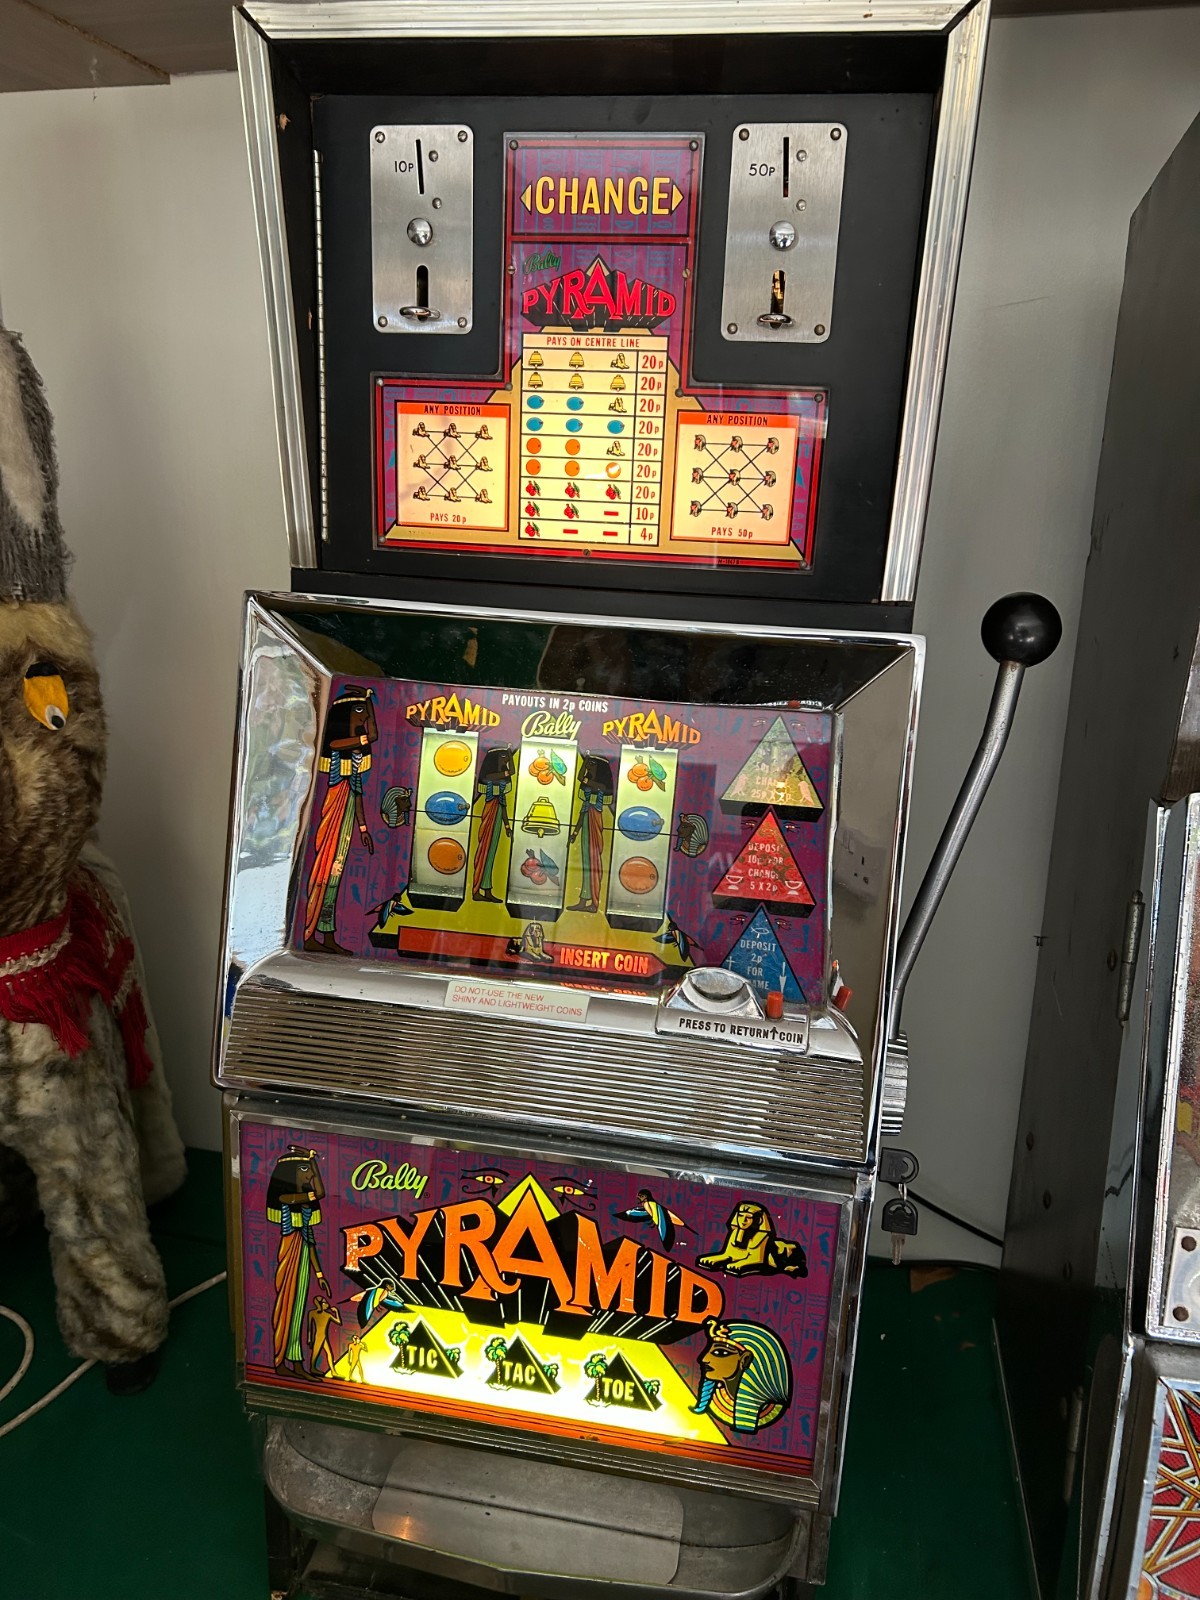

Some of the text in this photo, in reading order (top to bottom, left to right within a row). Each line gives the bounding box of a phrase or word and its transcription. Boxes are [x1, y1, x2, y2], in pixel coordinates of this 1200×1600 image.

[535, 176, 671, 215] CHANGE
[523, 251, 561, 275] Bally
[522, 260, 677, 320] PYRAMID
[546, 336, 640, 348] PAYS ON CENTRE LINE
[424, 405, 481, 416] ANY POSITION
[707, 414, 768, 426] ANY POSITION
[430, 512, 448, 522] PAYS
[712, 527, 733, 536] PAYS
[405, 692, 501, 727] PYRAMID
[502, 694, 609, 713] PAYOUTS IN 2p COINS
[521, 710, 582, 740] Bally
[602, 708, 701, 745] PYRAMID
[740, 941, 777, 952] DEPOSIT
[560, 947, 649, 974] INSERT COIN
[751, 953, 763, 964] 2p
[747, 966, 763, 977] FOR
[750, 980, 770, 990] AME
[452, 994, 583, 1016] SHINY AND LIGHTWEIGHT COINS
[525, 994, 545, 1002] NEW
[679, 1018, 804, 1044] PRESS TO RETURN COIN
[351, 1159, 429, 1199] Bally
[343, 1189, 723, 1323] PYRAMID
[408, 1345, 438, 1368] TIC
[503, 1361, 536, 1385] TAC
[601, 1377, 635, 1401] TOE
